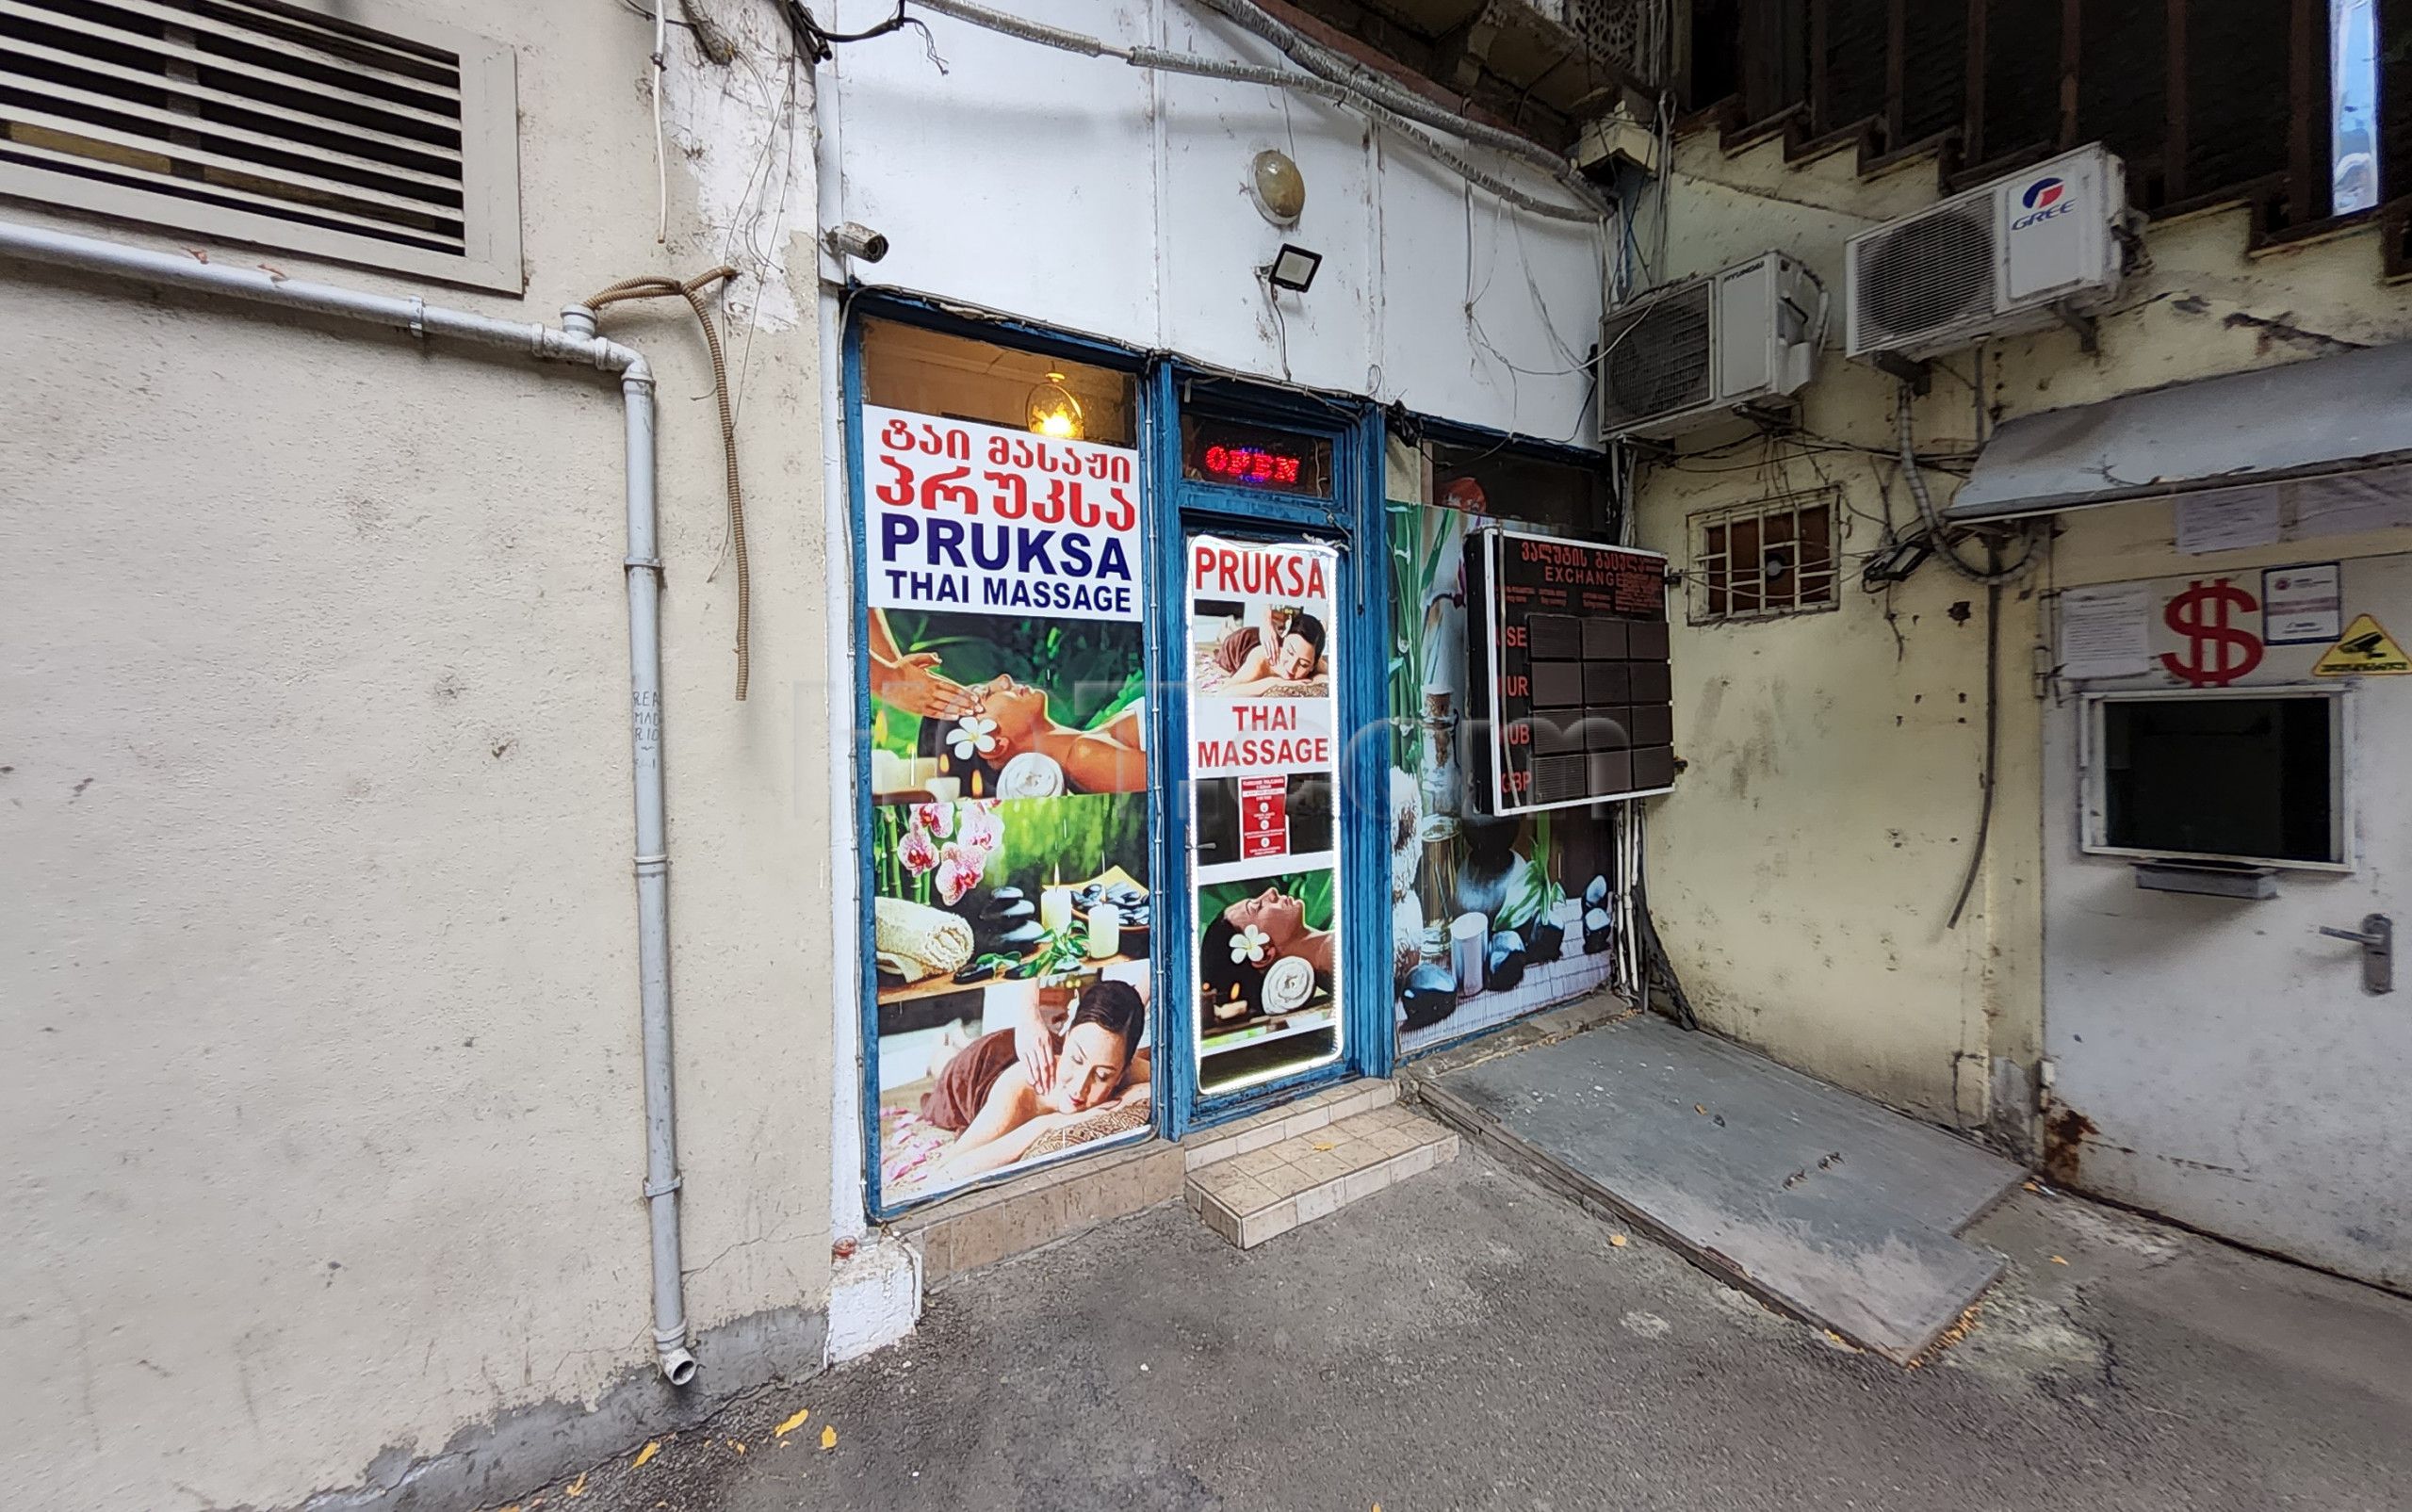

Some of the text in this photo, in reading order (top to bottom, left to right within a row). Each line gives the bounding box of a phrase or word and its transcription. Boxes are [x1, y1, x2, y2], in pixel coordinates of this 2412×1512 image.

[2011, 197, 2078, 231] GREE
[881, 418, 1132, 484] ტაი მასაჟი
[1205, 446, 1300, 482] OPEN
[875, 455, 1136, 532] პრუკსა
[881, 512, 1133, 581] PRUKSA
[885, 569, 1133, 613] THAI MASSAGE
[1195, 545, 1327, 600] PRUKSA
[1544, 566, 1624, 588] EXCHANGE
[1232, 706, 1297, 732] THAI
[1198, 738, 1329, 768] MASSAGE
